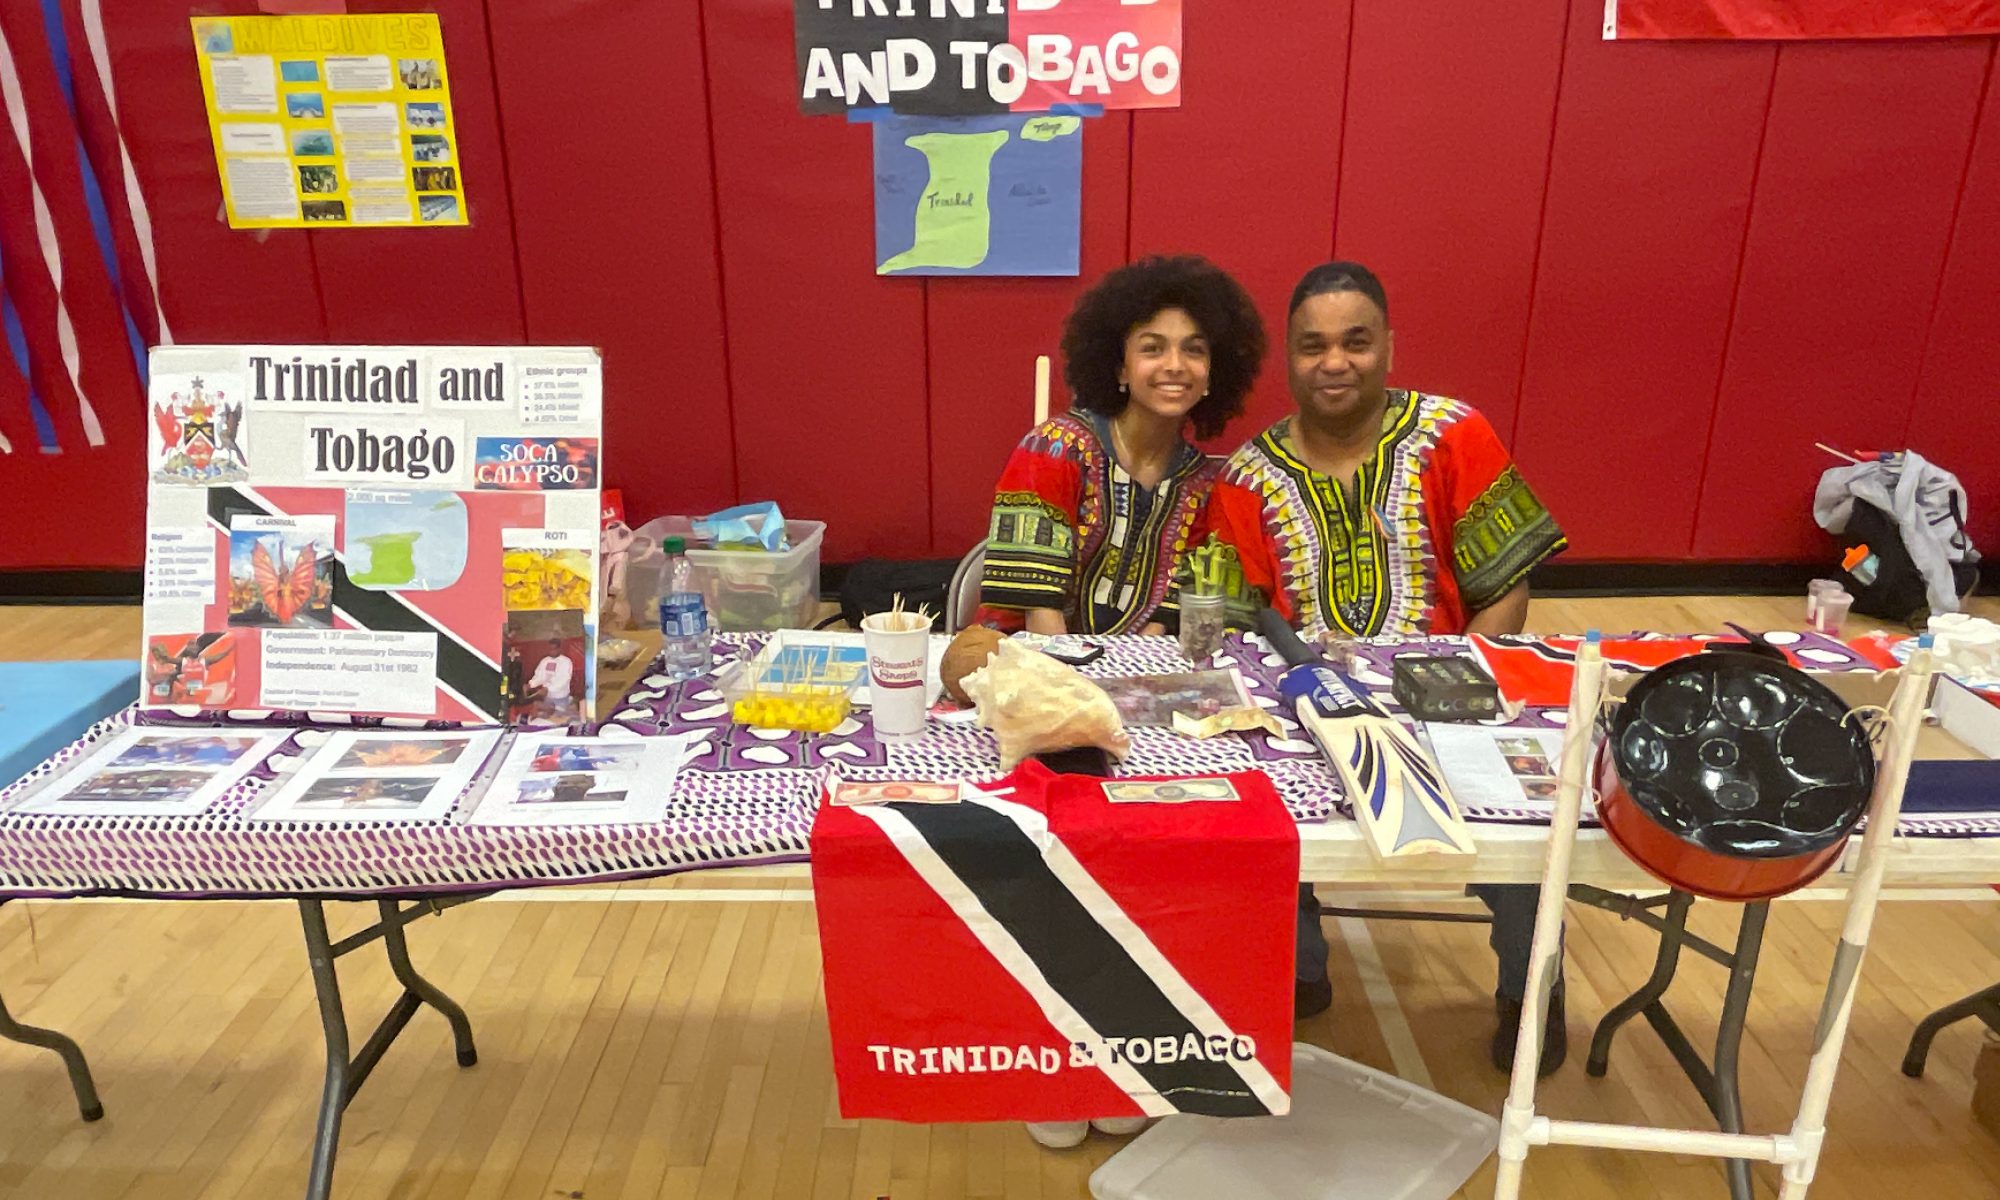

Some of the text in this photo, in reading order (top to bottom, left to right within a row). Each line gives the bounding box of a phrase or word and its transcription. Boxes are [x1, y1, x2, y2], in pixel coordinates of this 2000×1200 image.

[236, 17, 430, 51] MALDIVES
[803, 32, 1180, 105] AND TOBAGO
[249, 356, 505, 404] Trinidad and
[310, 427, 455, 480] Tobago
[500, 443, 557, 463] SOCA
[477, 464, 579, 484] CALYPSO
[255, 518, 297, 528] CARNIVAL
[544, 530, 568, 541] ROTI
[265, 644, 326, 655] Government:
[387, 647, 434, 659] Democracy
[265, 660, 336, 671] Independence:
[340, 661, 373, 673] August
[866, 1033, 1257, 1076] TRINIDAD & TOBAGO
